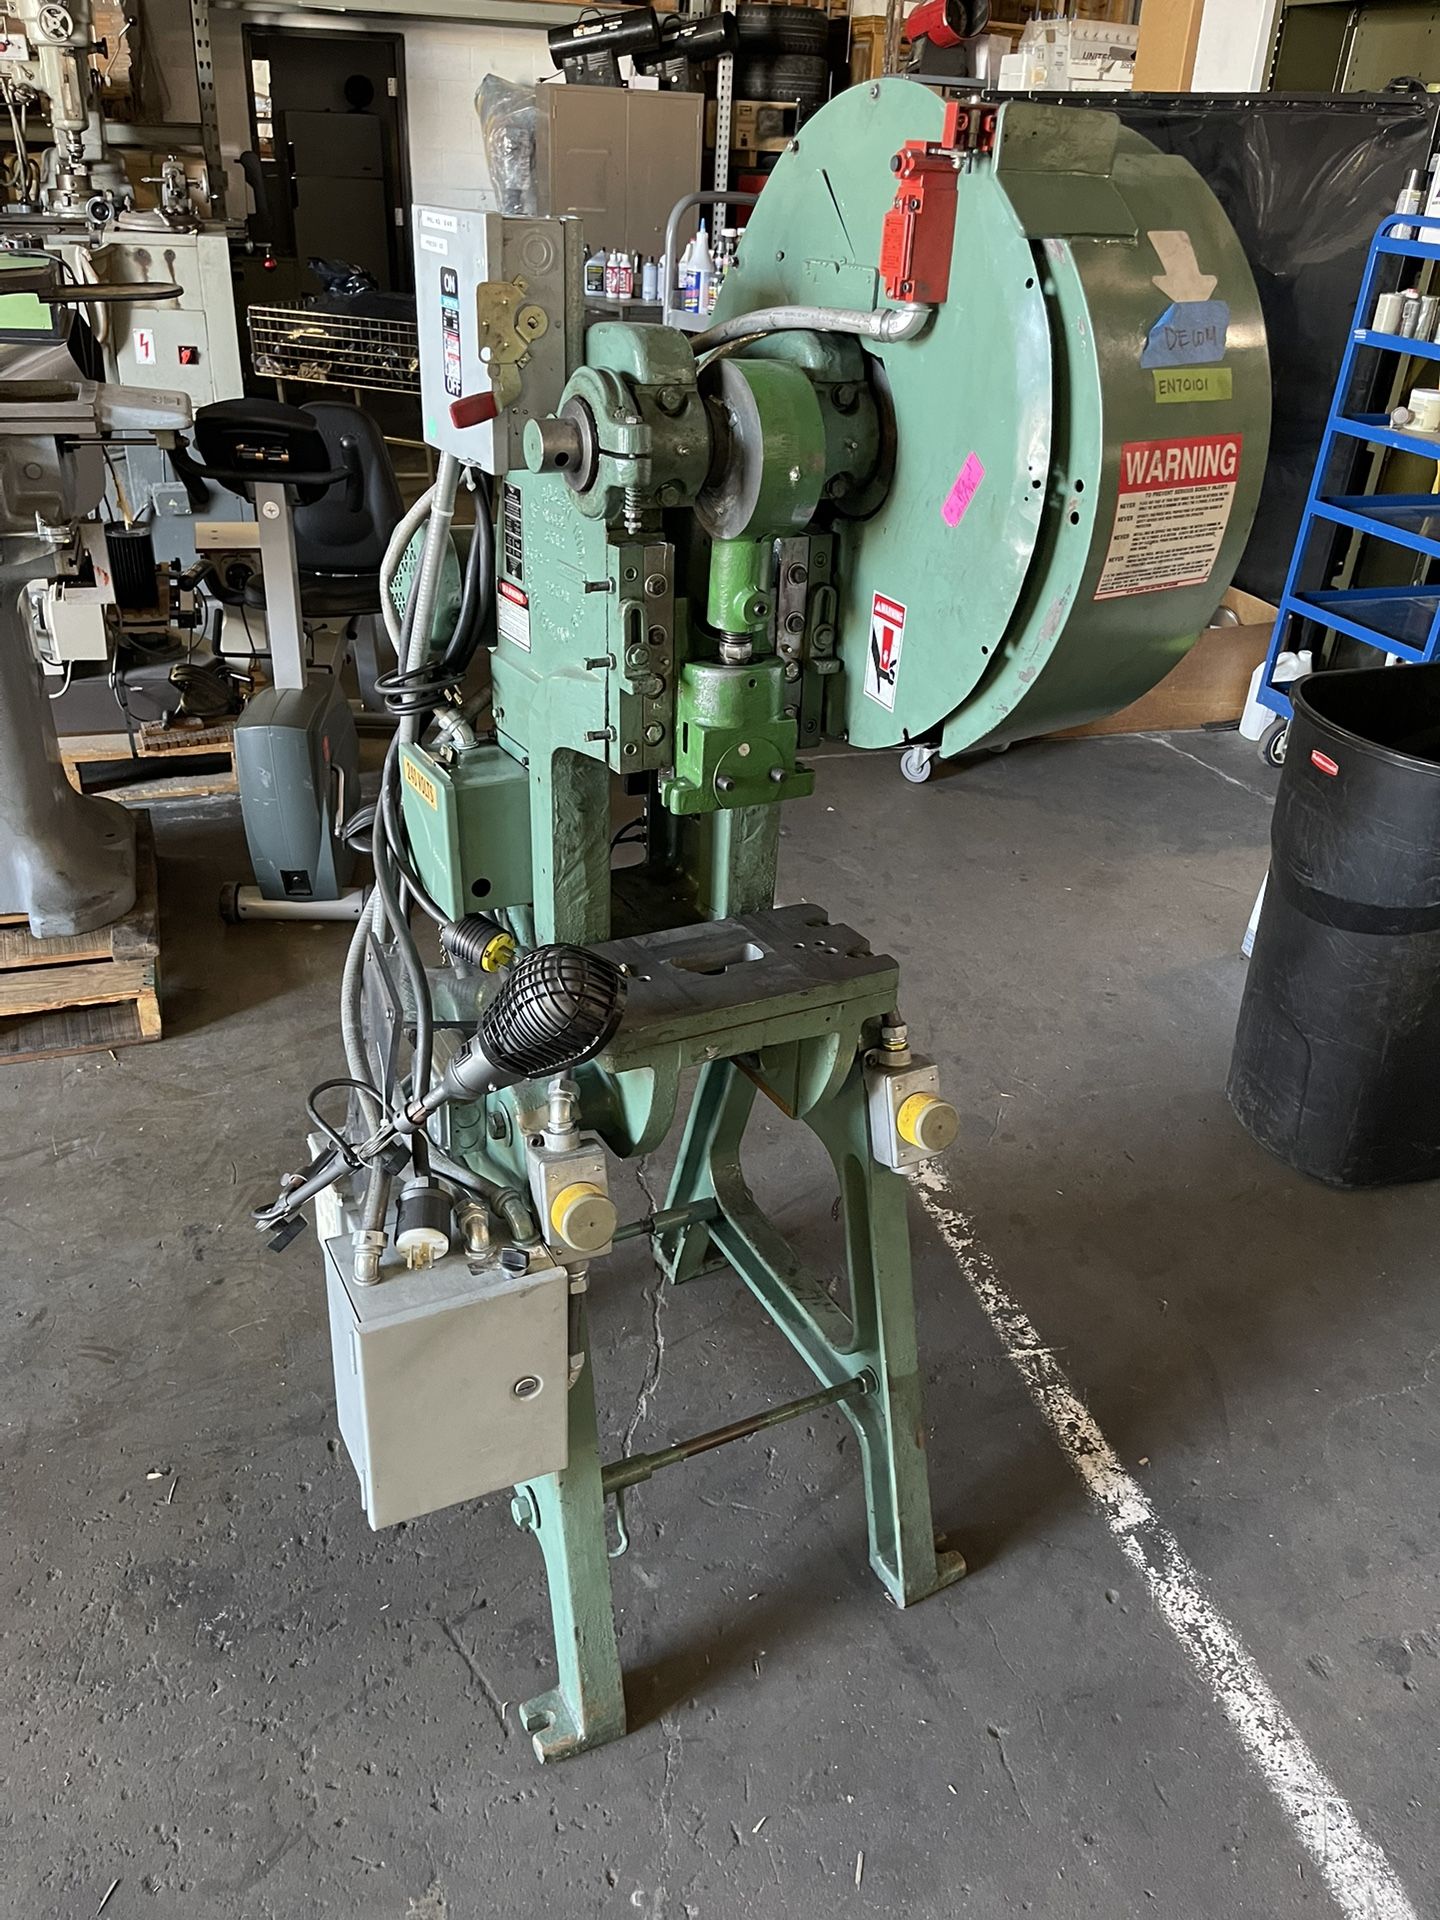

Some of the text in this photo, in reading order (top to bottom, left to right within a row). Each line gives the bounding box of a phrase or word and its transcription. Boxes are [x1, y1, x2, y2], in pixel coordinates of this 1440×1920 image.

[444, 273, 455, 293] ON
[447, 376, 461, 395] OFF
[1159, 378, 1208, 394] EN70101
[1126, 442, 1238, 485] WARNING
